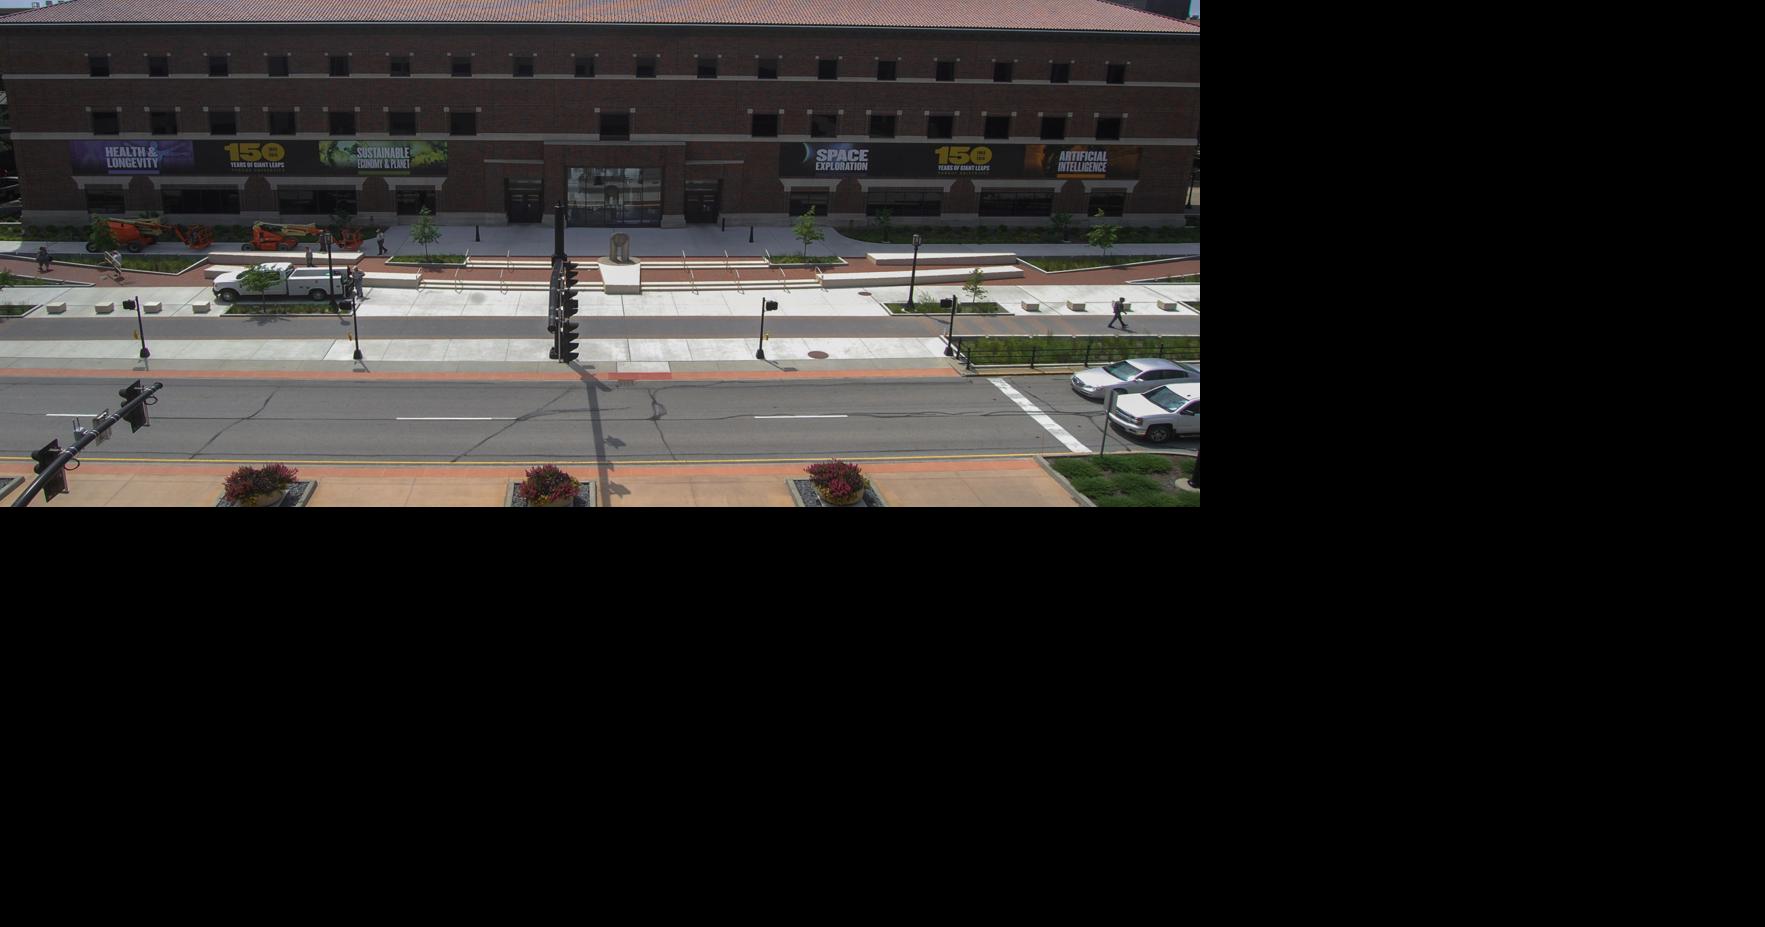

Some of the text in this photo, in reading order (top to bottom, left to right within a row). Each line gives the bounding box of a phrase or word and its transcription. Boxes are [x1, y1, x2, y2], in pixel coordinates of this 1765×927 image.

[105, 146, 158, 157] HEALTH &
[224, 143, 285, 161] 150
[357, 147, 410, 158] SUSTAINABLE
[816, 149, 869, 161] SPACE
[935, 146, 992, 164] 150
[1059, 151, 1108, 161] ARTIFICIAL
[107, 158, 158, 168] LONGEVITY
[358, 159, 410, 168] ECONOMY & PLANET
[815, 162, 868, 171] EXPLORATION
[1058, 162, 1107, 172] INTELLIGENCE
